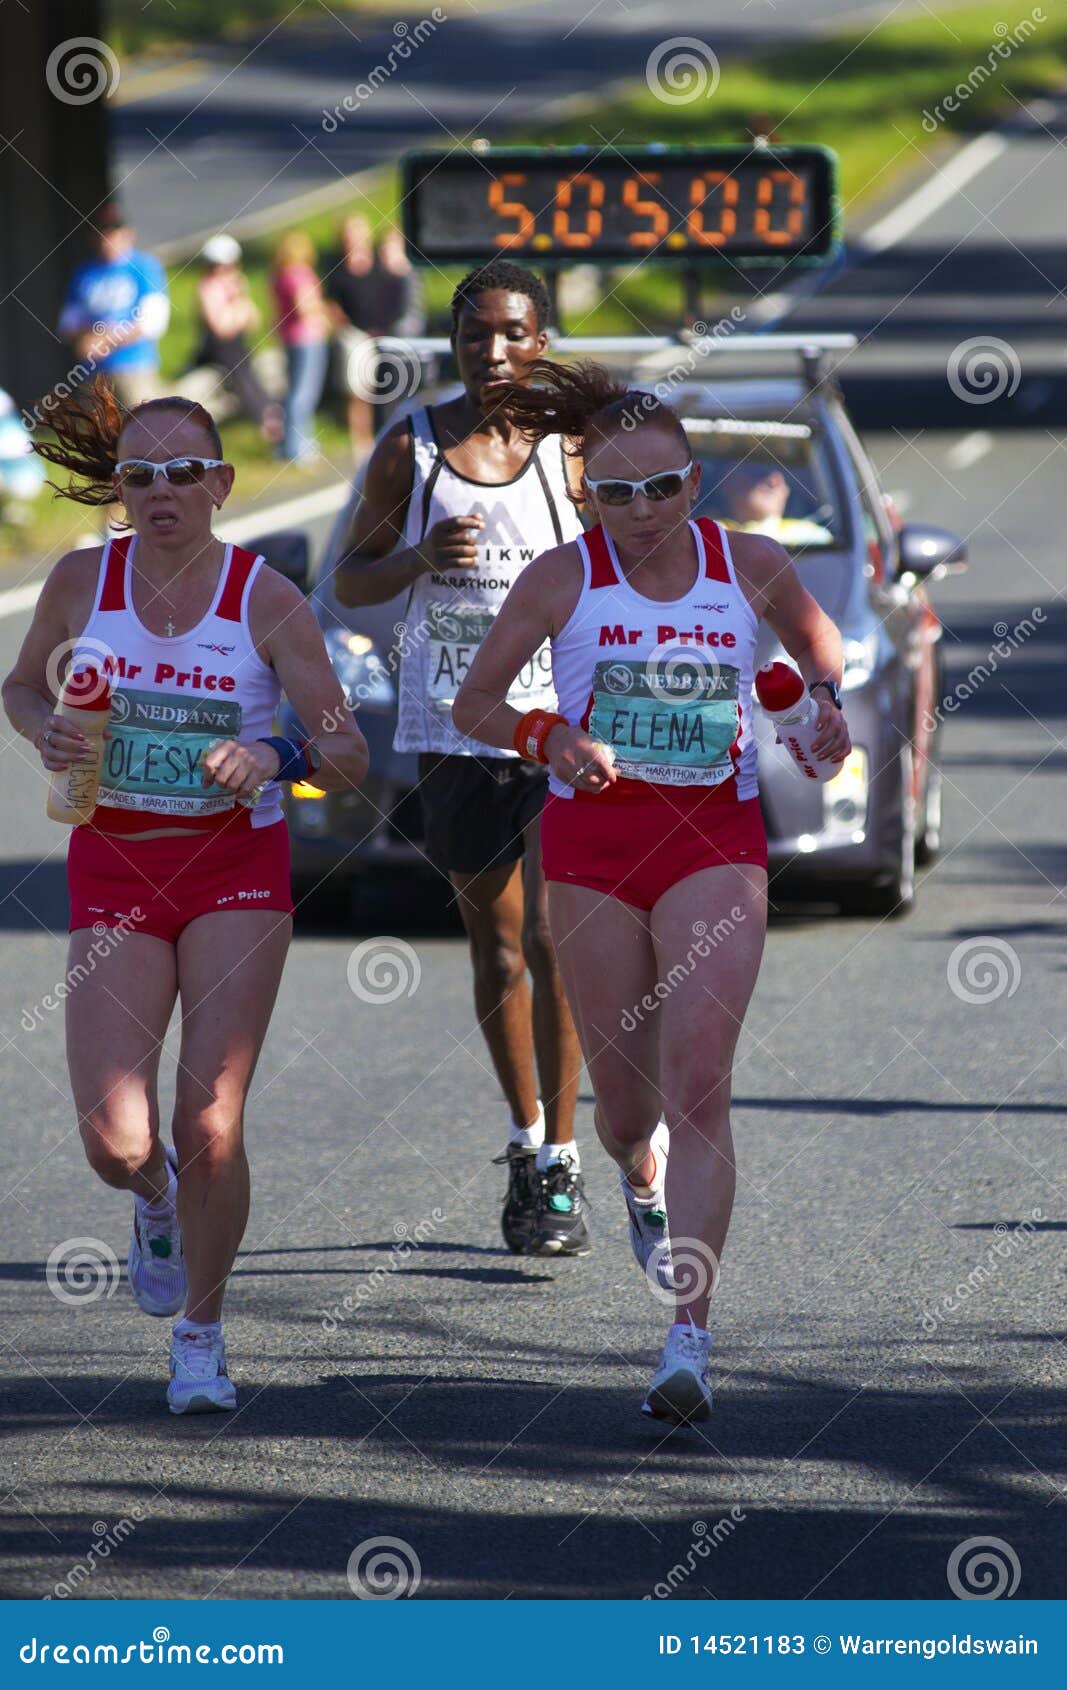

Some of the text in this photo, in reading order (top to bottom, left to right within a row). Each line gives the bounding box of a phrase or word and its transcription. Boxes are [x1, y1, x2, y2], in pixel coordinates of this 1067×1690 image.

[430, 575, 510, 590] MARATHON
[598, 625, 736, 649] Mr Price
[102, 655, 237, 692] Mr Price
[639, 675, 730, 692] NEDBANK
[135, 703, 231, 728] NEDBANK
[611, 710, 706, 754] ELENA
[108, 737, 205, 785] OLESY
[645, 767, 697, 780] MARATHON
[804, 764, 819, 779] Mr
[142, 797, 194, 810] MARATHON
[238, 889, 271, 901] Price
